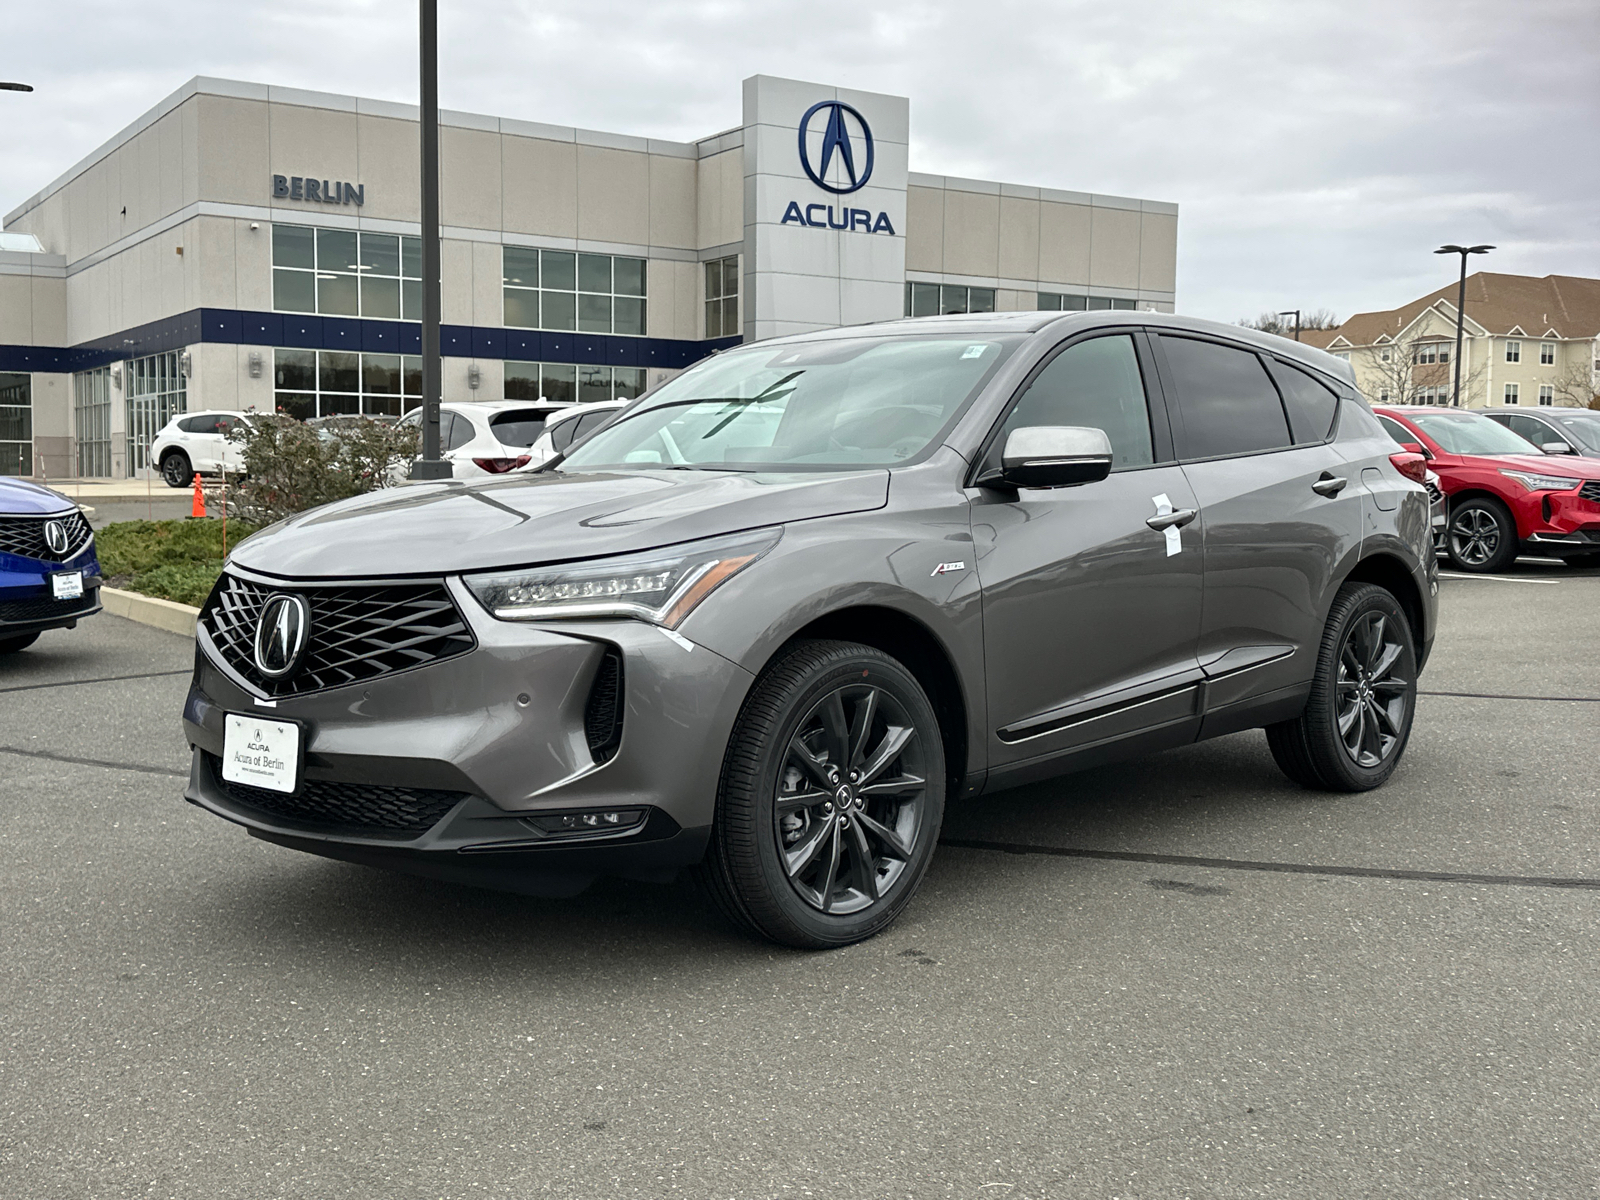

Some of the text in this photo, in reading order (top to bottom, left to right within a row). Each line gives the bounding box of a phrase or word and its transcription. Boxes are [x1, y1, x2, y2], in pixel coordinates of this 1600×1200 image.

[273, 174, 364, 206] BERLIN
[781, 201, 896, 235] ACURA
[234, 751, 285, 770] Acura of Berlin
[247, 743, 270, 753] ACURA
